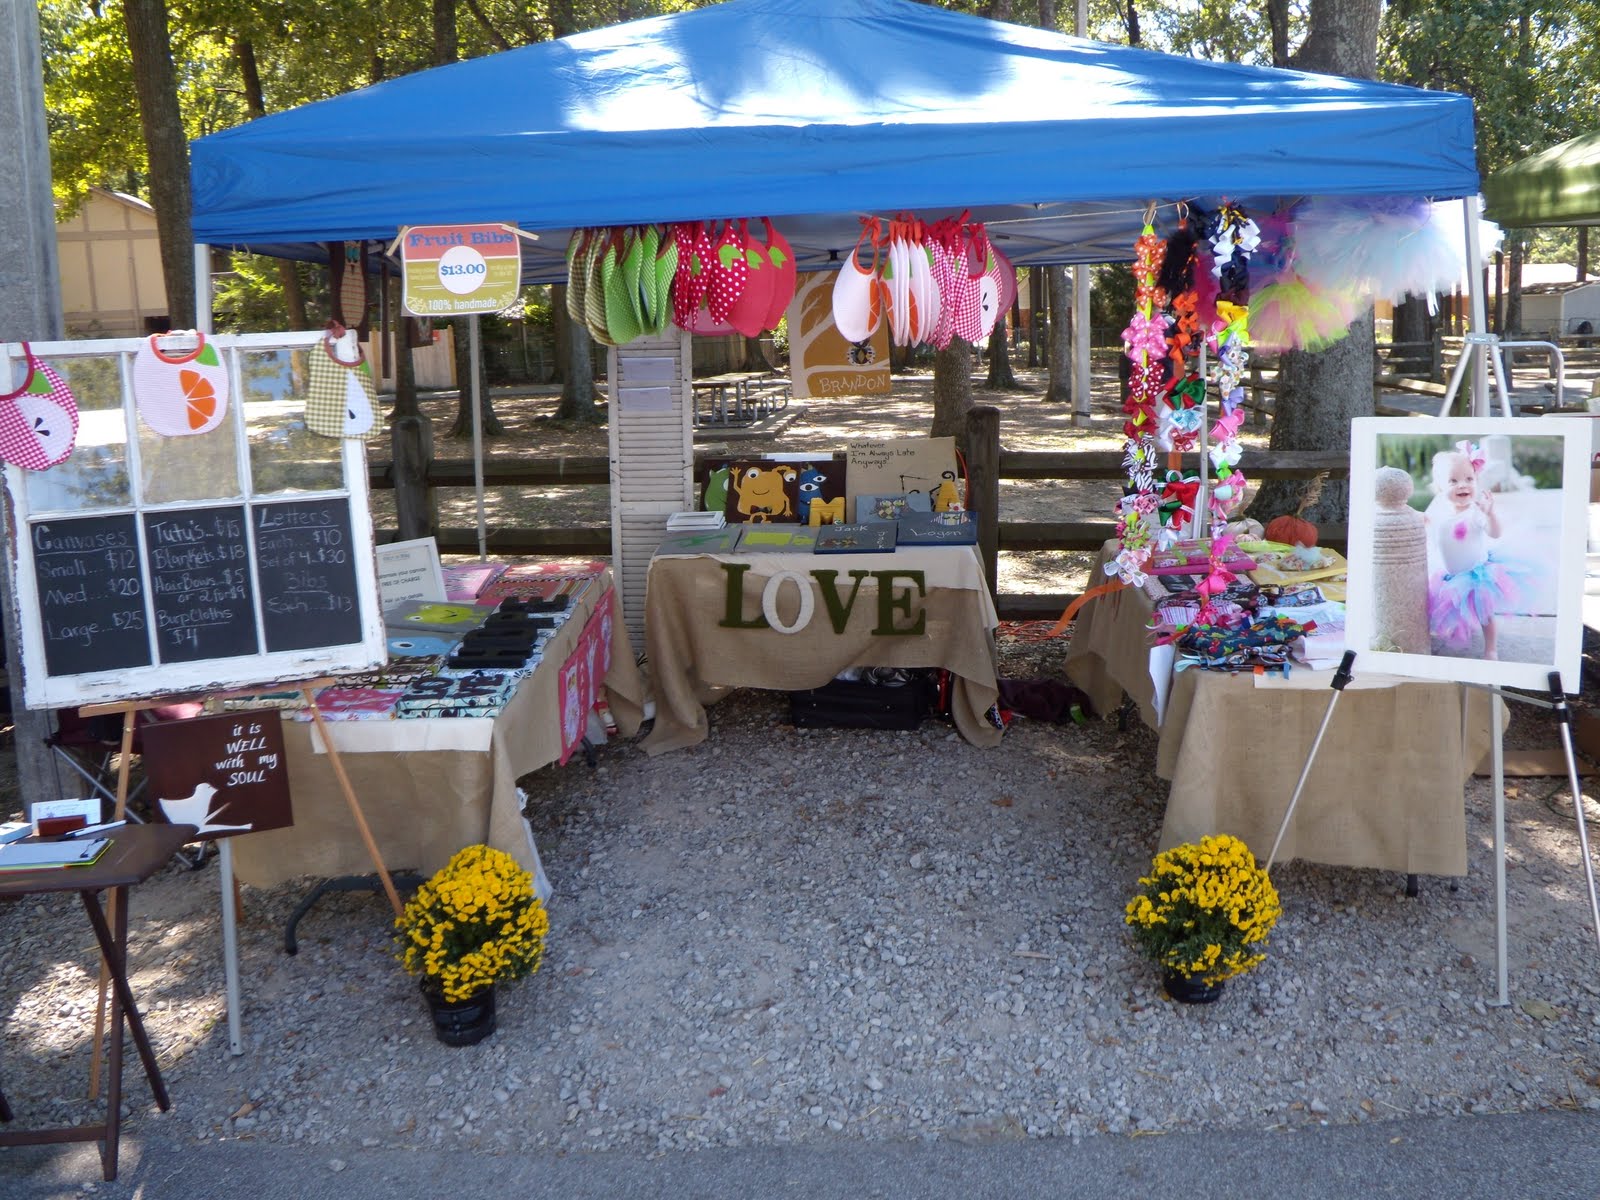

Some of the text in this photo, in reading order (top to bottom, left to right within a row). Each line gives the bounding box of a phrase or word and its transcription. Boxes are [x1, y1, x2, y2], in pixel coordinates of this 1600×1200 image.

[408, 231, 513, 247] Fruit Bibs
[440, 263, 486, 276] $13.00
[428, 297, 497, 311] 100% handmade
[819, 374, 886, 393] BRANDON
[869, 449, 894, 460] Always
[896, 448, 916, 456] Late
[259, 507, 332, 528] Letters
[214, 516, 241, 538] $15
[834, 525, 868, 533] Jack
[312, 529, 342, 546] $10
[104, 550, 136, 571] $12
[218, 544, 246, 560] $18
[318, 548, 346, 564] $30
[222, 568, 245, 585] $5
[107, 578, 140, 596] $20
[327, 594, 353, 612] $13
[718, 563, 927, 635] LOVE
[112, 611, 144, 630] $25
[171, 629, 198, 647] $4
[233, 723, 262, 737] it is
[226, 736, 268, 754] WELL
[215, 753, 277, 770] with my
[226, 769, 267, 786] SOUL
